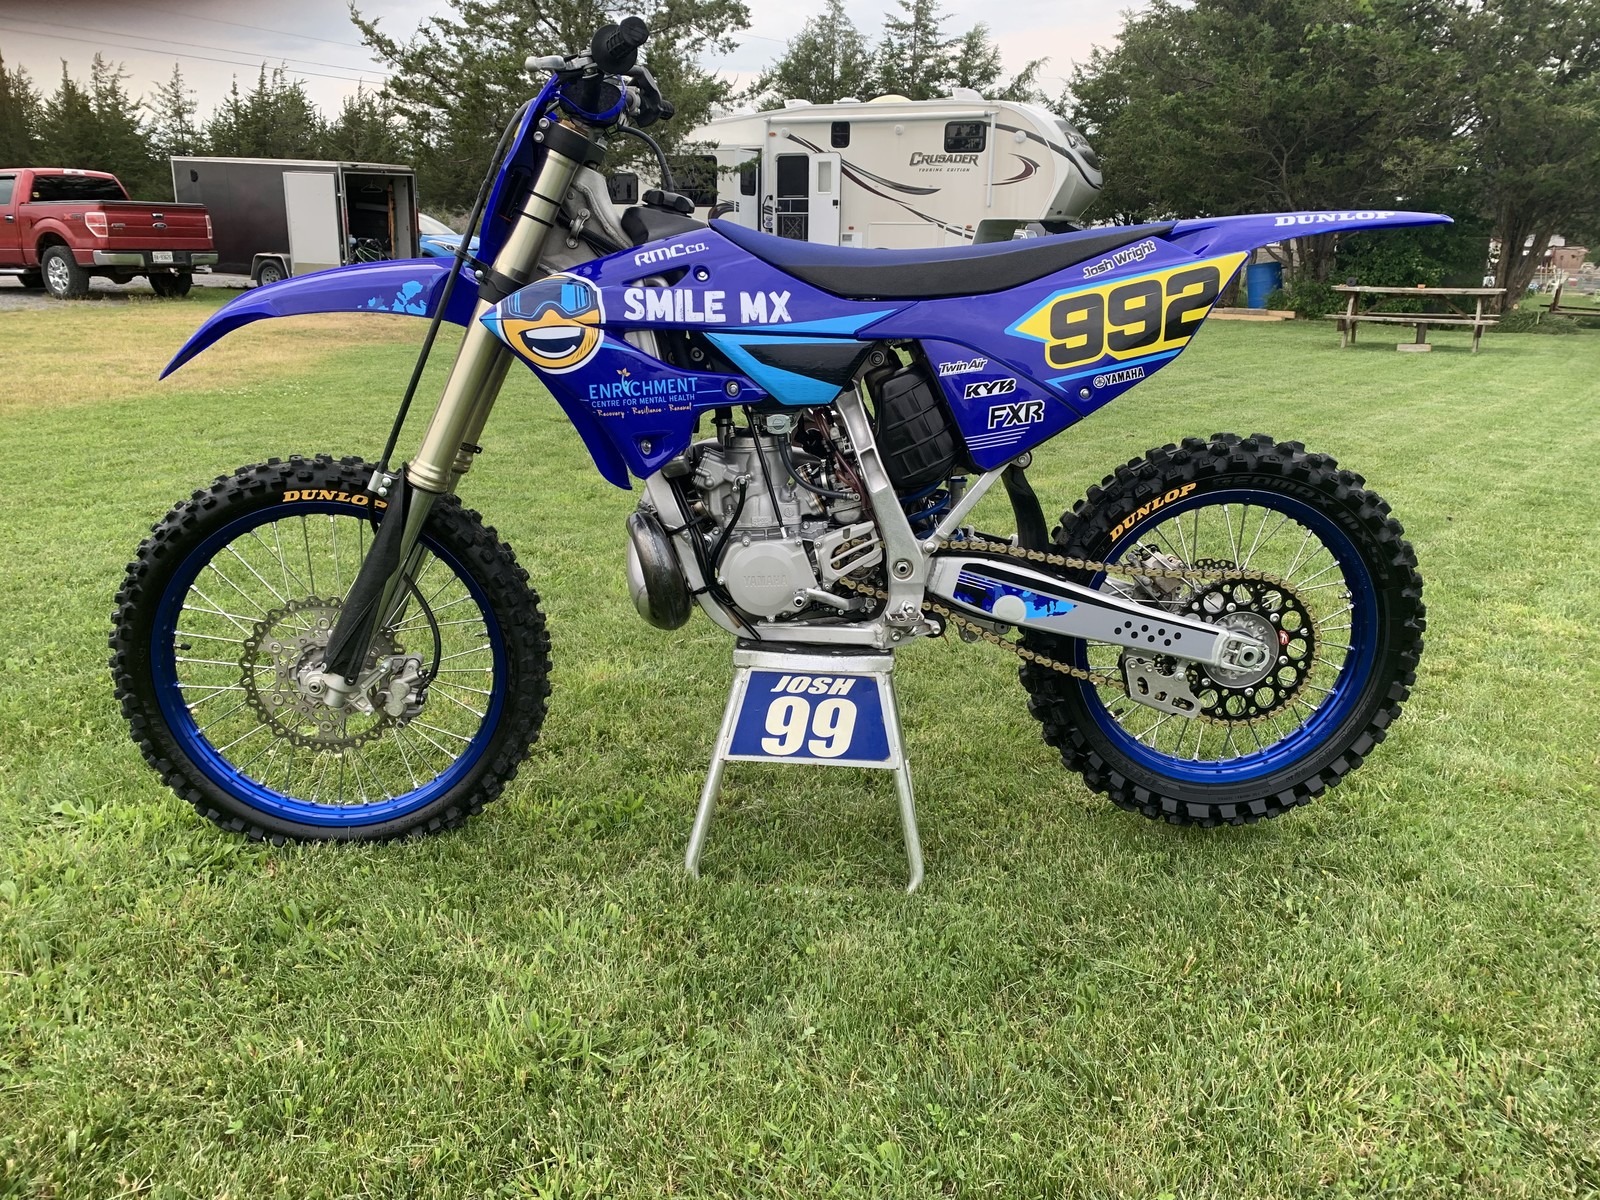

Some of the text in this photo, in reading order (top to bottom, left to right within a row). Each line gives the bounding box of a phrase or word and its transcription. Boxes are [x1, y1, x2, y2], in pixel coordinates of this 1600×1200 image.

[909, 152, 979, 167] CRUSADER
[1274, 212, 1395, 227] DUNLOP
[1084, 240, 1156, 279] Josh Wright
[624, 288, 792, 323] SMILE MX
[1050, 266, 1220, 365] 992
[940, 362, 967, 374] Twin
[968, 358, 987, 371] Air
[1105, 367, 1145, 385] YAMAHA
[589, 377, 698, 400] ENRICHMENT
[965, 379, 1016, 398] KYB
[591, 394, 695, 408] CENTRE FOR MENTAL HEALTH
[597, 409, 625, 418] Recovery
[988, 400, 1045, 429] FXR
[282, 489, 388, 509] DUNLOP
[1109, 482, 1197, 543] DUNLOP
[770, 675, 856, 696] JOSH
[761, 695, 858, 758] 99
